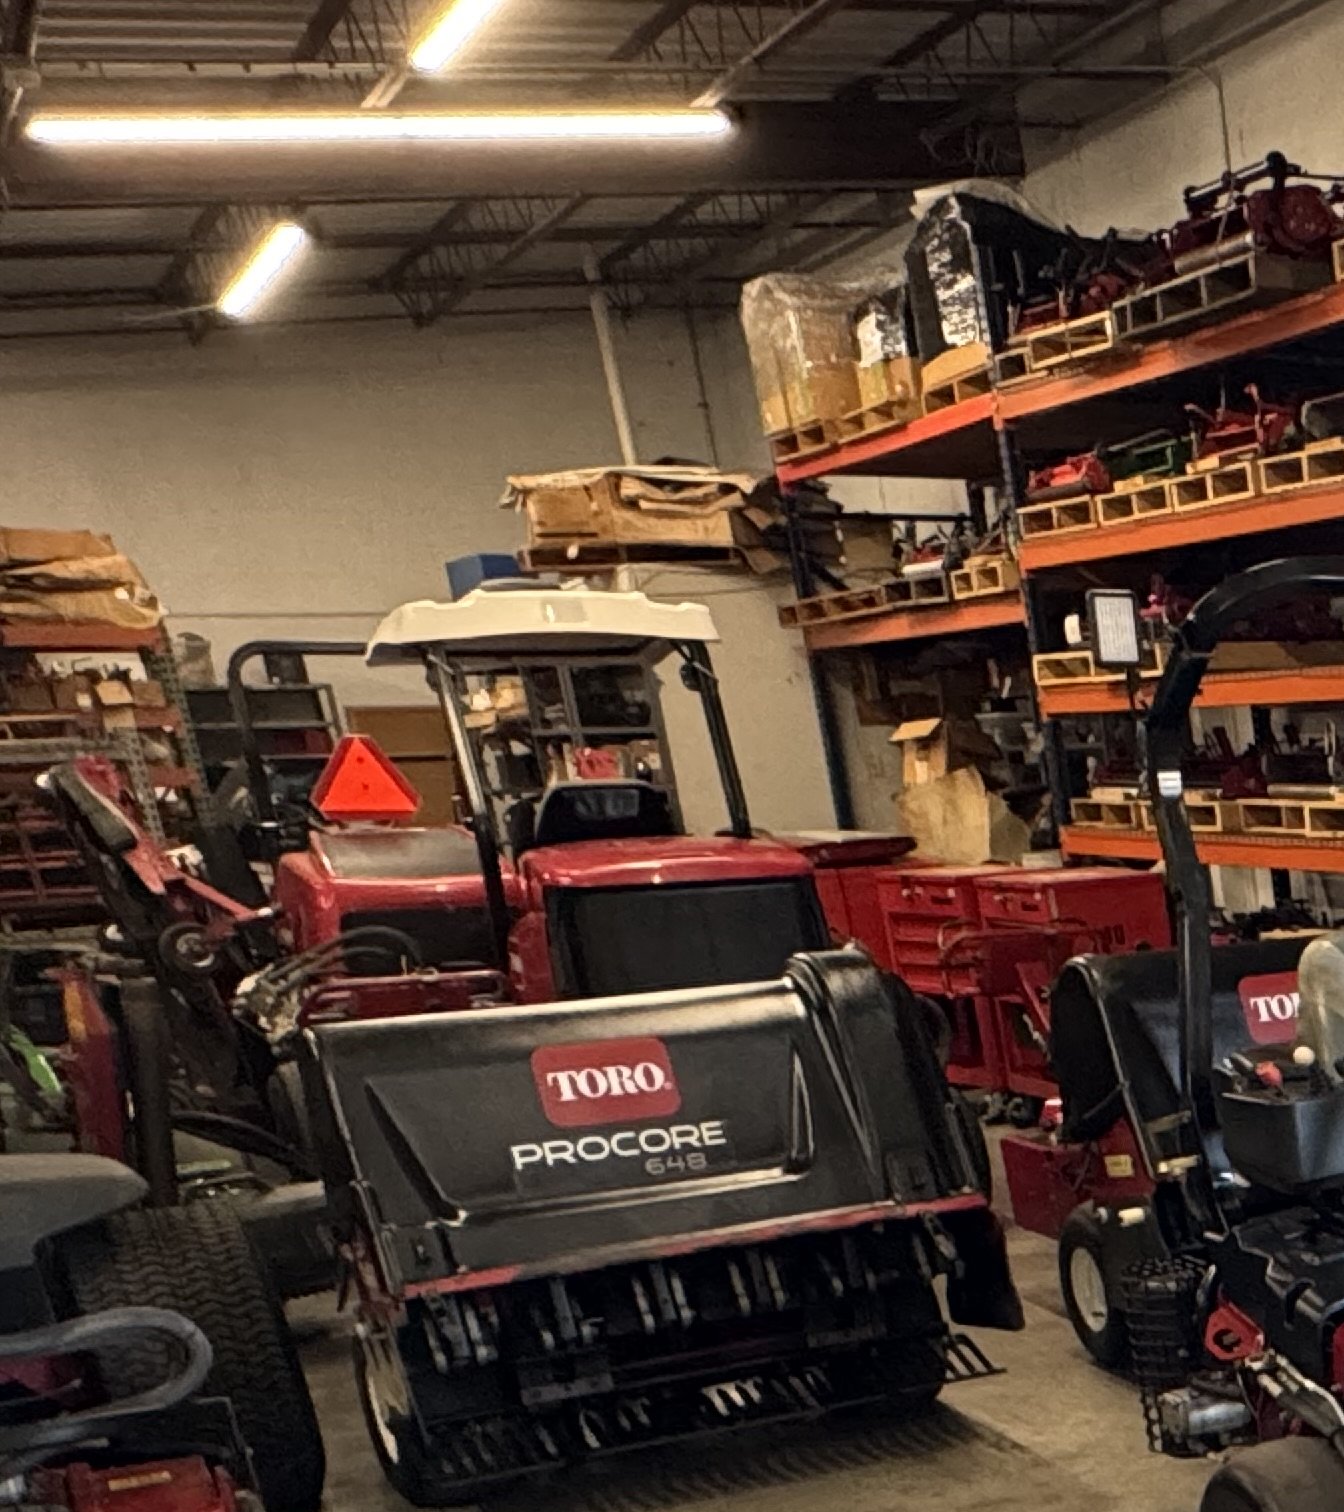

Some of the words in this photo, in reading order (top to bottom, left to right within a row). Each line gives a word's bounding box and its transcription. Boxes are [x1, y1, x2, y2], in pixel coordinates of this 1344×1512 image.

[1249, 992, 1300, 1022] TO
[546, 1062, 666, 1101] TORO
[511, 1121, 727, 1170] PROCORE
[645, 1153, 708, 1175] 648
